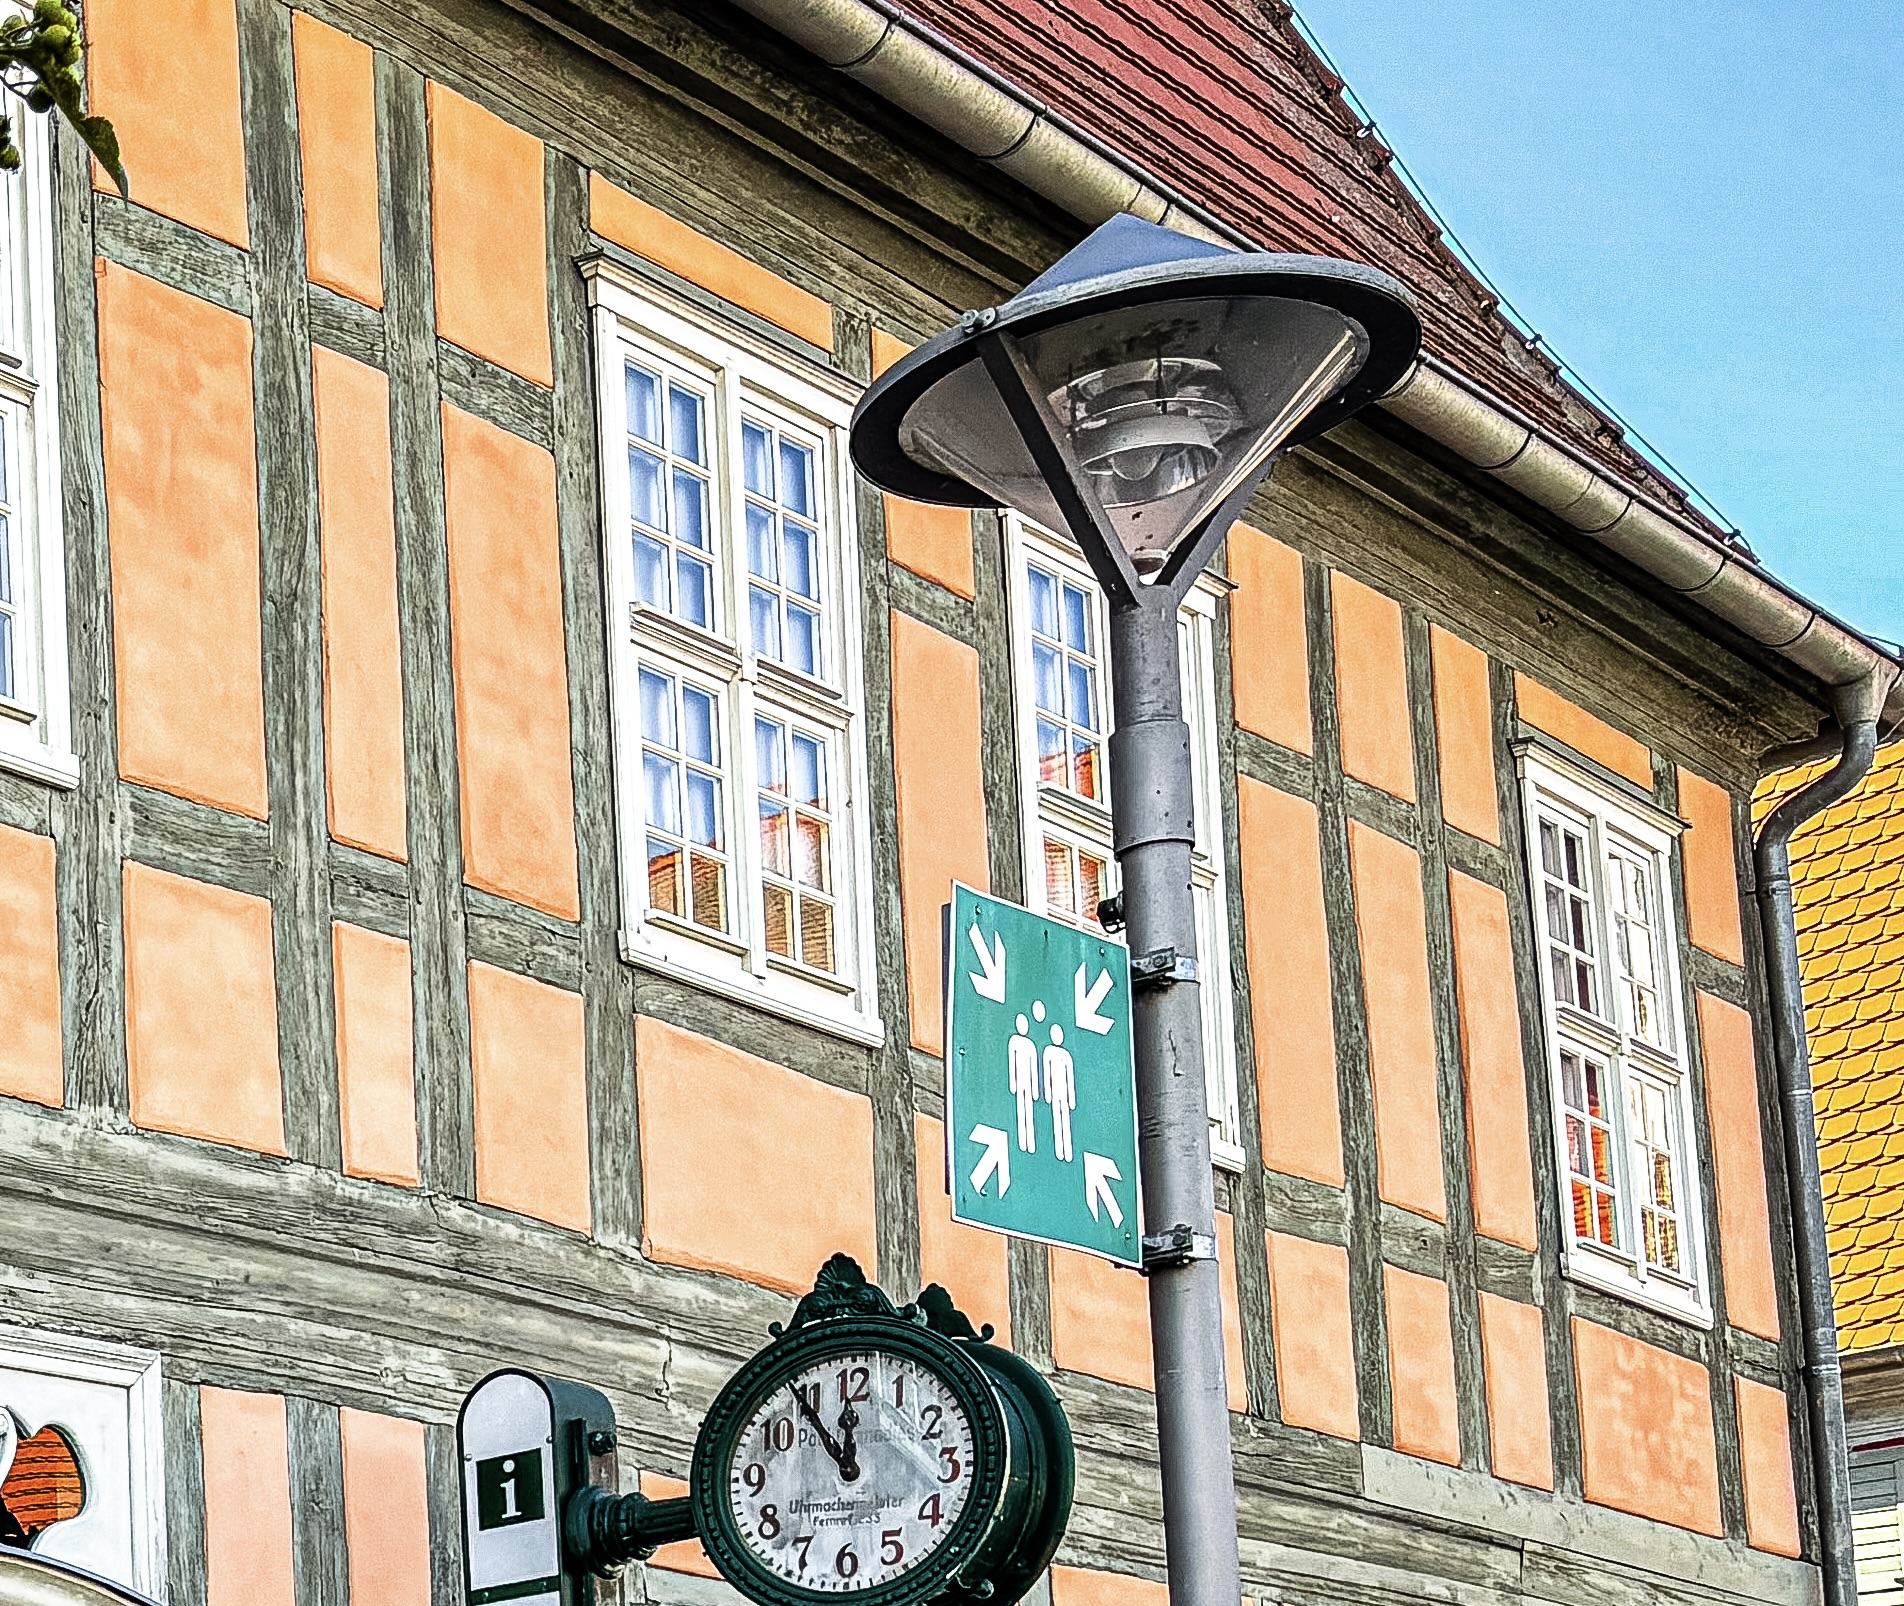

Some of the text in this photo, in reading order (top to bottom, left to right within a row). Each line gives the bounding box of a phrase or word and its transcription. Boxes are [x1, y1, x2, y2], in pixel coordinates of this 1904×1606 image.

[836, 1367, 870, 1403] 12
[892, 1375, 904, 1409] 1
[760, 1417, 794, 1452] 10
[921, 1404, 943, 1441] 2
[743, 1463, 766, 1497] 9
[937, 1446, 961, 1484] 3
[758, 1504, 780, 1540] 8
[918, 1493, 944, 1528] 4
[792, 1535, 814, 1573] 7
[835, 1542, 859, 1579] 6
[881, 1527, 904, 1566] 5
